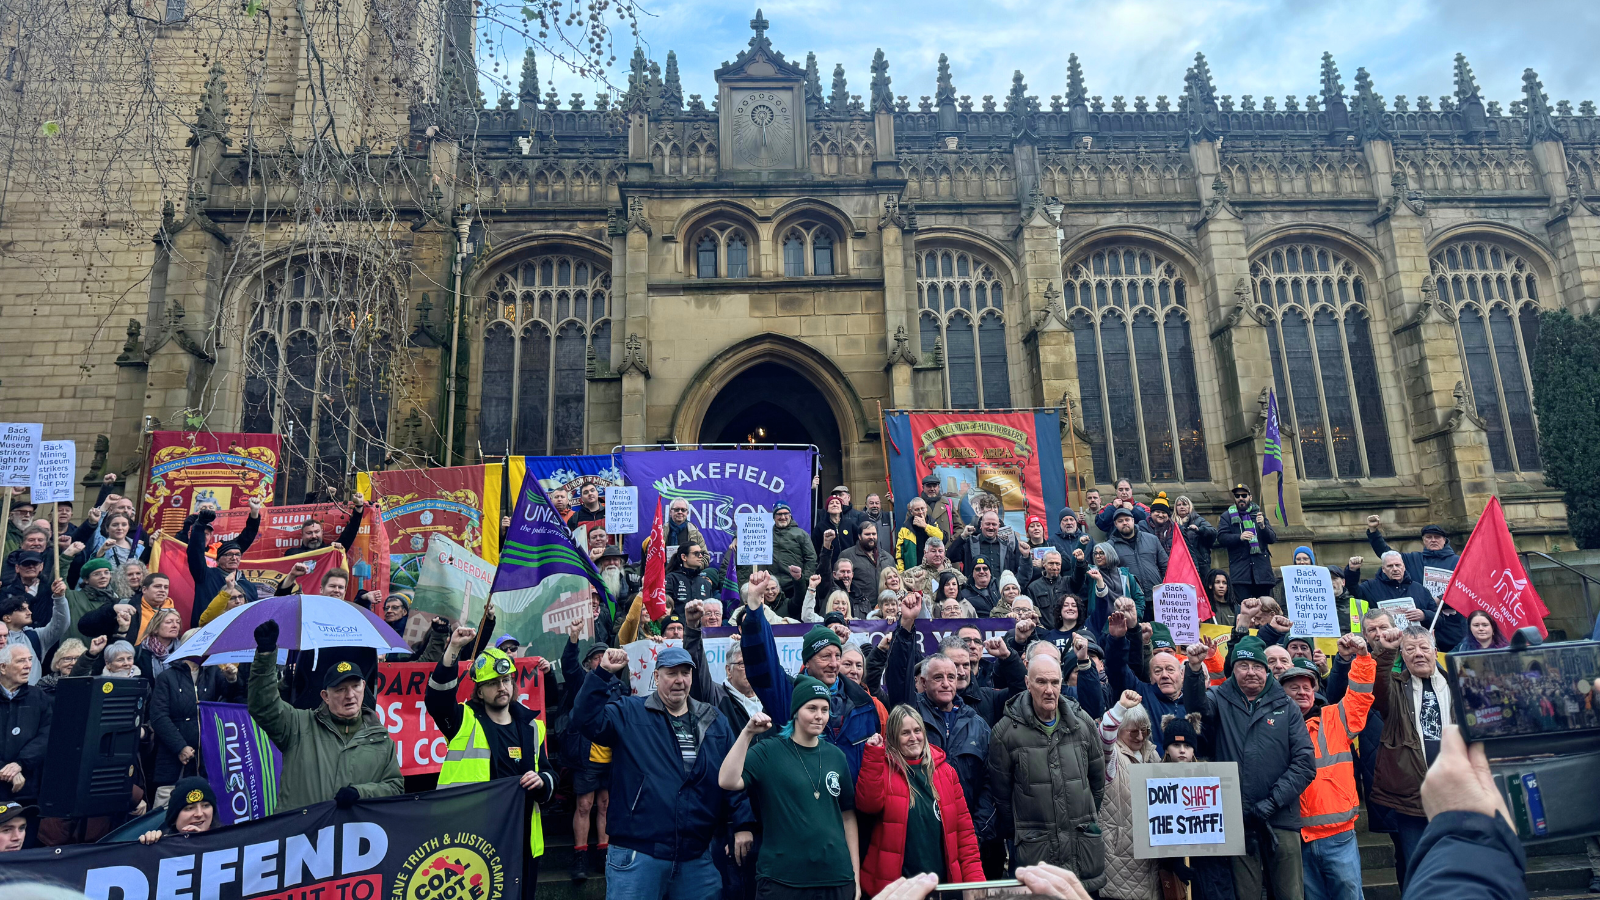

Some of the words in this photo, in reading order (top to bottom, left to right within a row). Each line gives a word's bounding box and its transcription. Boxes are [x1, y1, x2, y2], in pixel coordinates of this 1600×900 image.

[8, 426, 28, 434] Back
[951, 423, 970, 433] UNION
[3, 434, 31, 442] Mining
[0, 441, 33, 449] Museum
[40, 451, 67, 459] Mining
[38, 465, 69, 473] strikers
[38, 472, 58, 480] fight
[656, 462, 785, 494] WAKEFIELD
[55, 480, 69, 488] pay
[272, 514, 312, 524] SALFORD
[213, 531, 242, 543] Trade
[438, 552, 492, 585] CALDERDAL
[1296, 569, 1318, 577] Back
[1294, 577, 1322, 587] Mining
[1291, 585, 1327, 594] Museum
[1162, 592, 1188, 600] Mining
[1294, 594, 1326, 602] strikers
[1159, 599, 1191, 607] Museum
[1295, 602, 1314, 611] fight
[1315, 602, 1328, 611] for
[1161, 606, 1190, 614] strikers
[1161, 613, 1179, 622] fight
[1180, 613, 1191, 621] for
[1296, 611, 1311, 619] fair
[1312, 612, 1328, 620] pay
[317, 625, 358, 633] UNISON
[1177, 622, 1191, 630] pay
[1148, 782, 1179, 806] DON'T
[1181, 784, 1220, 807] SHAFT
[1149, 815, 1174, 835] THE
[1176, 813, 1224, 835] STAFF!
[402, 837, 440, 870] TRUTH
[442, 833, 451, 845] &
[454, 831, 496, 859] JUSTICE
[83, 821, 389, 900] DEFEND
